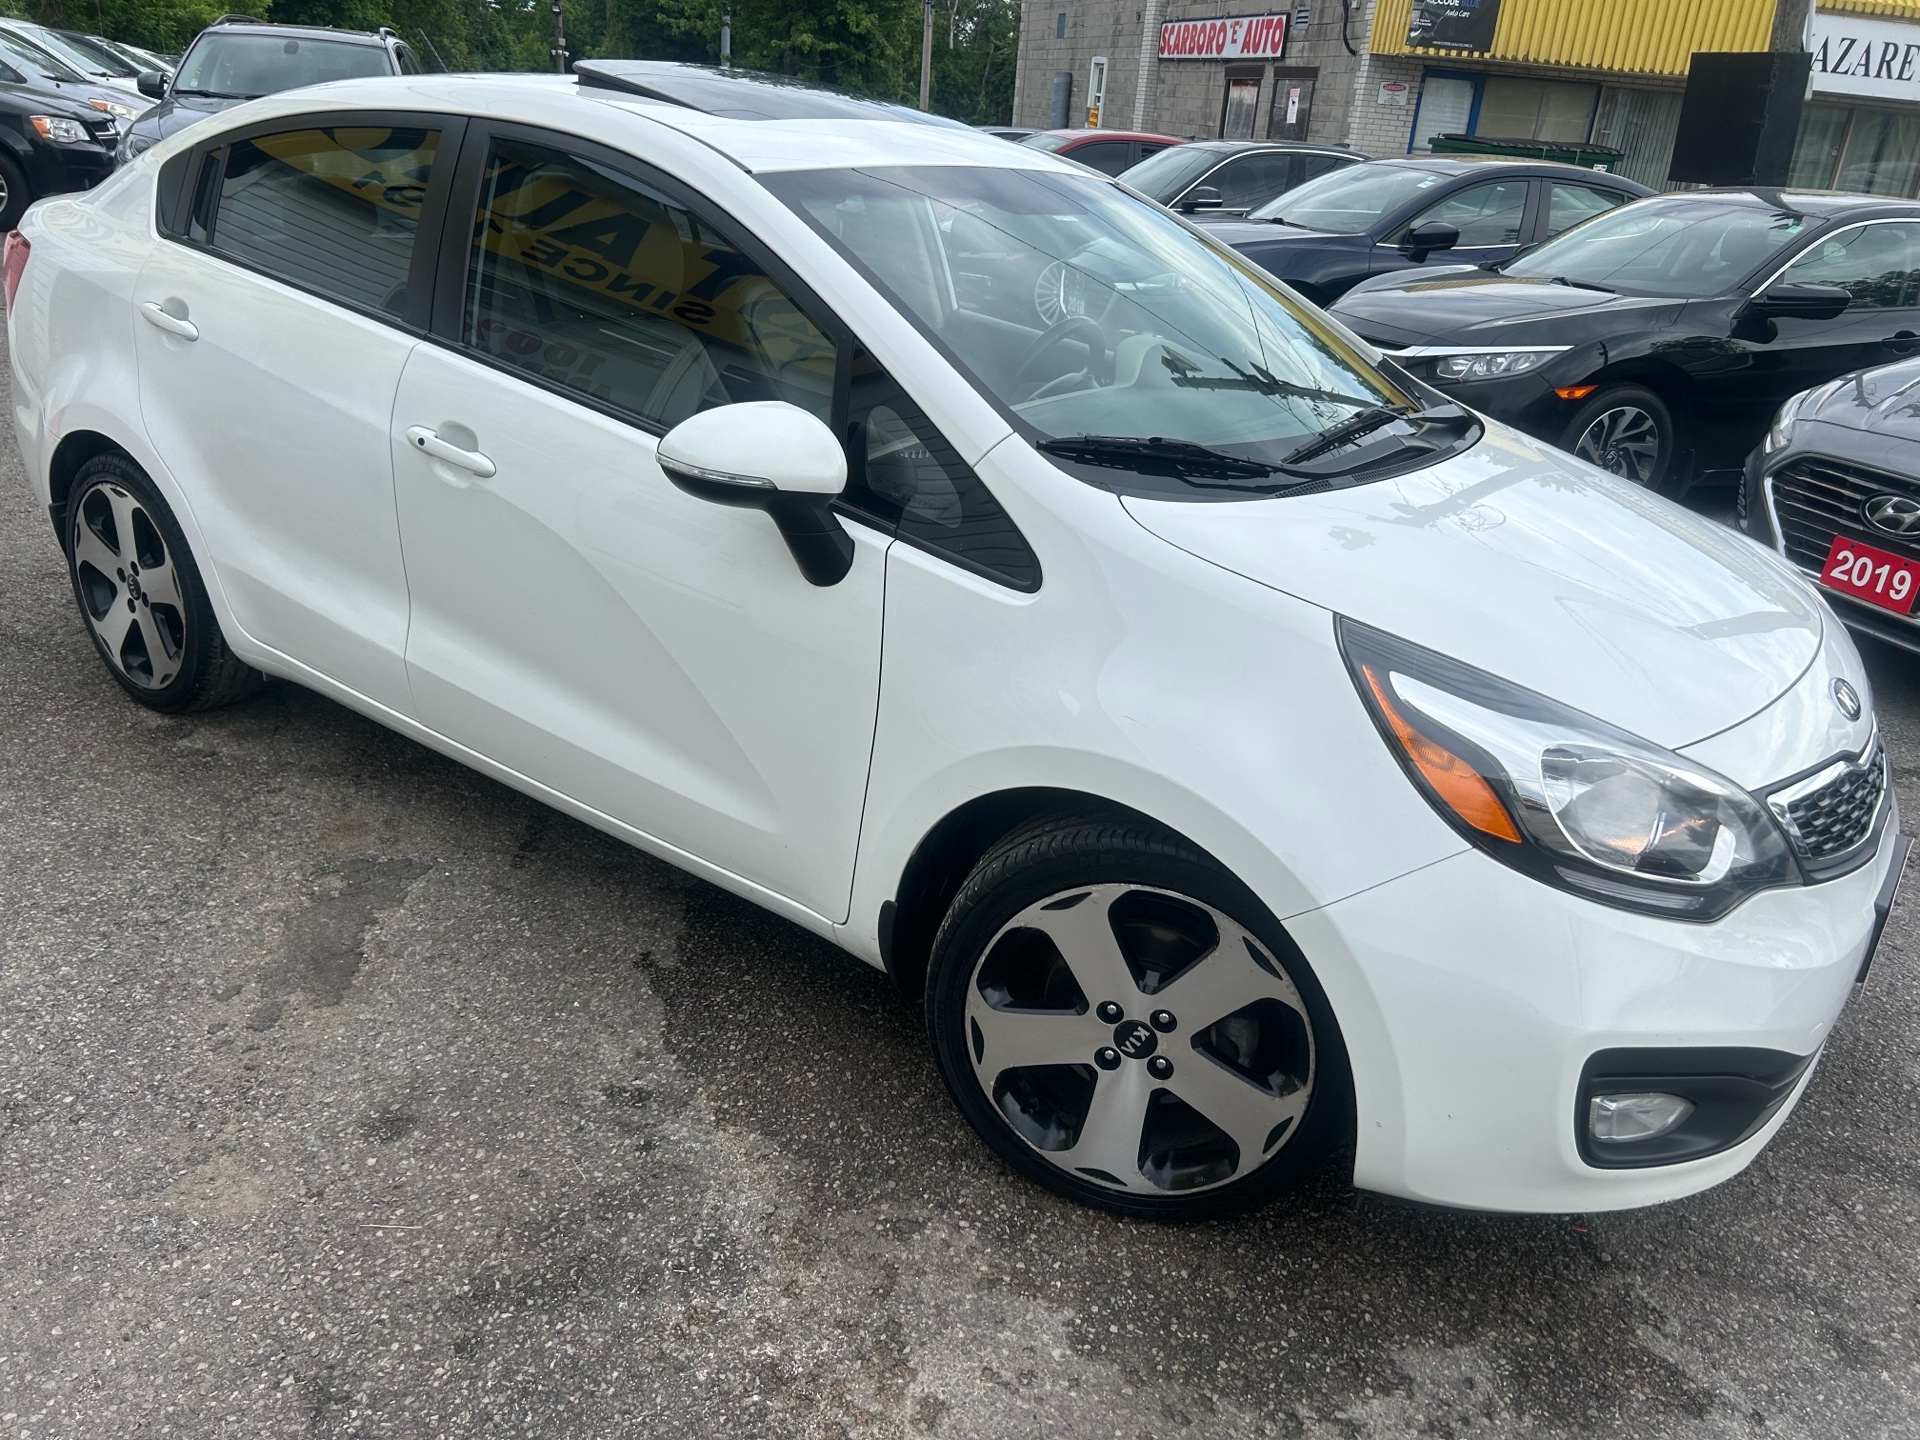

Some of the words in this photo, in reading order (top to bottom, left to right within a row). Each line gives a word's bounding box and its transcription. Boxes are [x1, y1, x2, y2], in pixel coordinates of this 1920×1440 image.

[1445, 9, 1458, 17] Auto
[1459, 10, 1470, 18] Care
[1159, 21, 1227, 55] SCARBORO
[1240, 17, 1284, 54] AUTO
[1810, 33, 1920, 82] AZARE
[90, 464, 122, 476] MIRAGE
[128, 576, 138, 598] KIA
[1829, 550, 1912, 600] 2019
[1120, 1025, 1150, 1054] KIA
